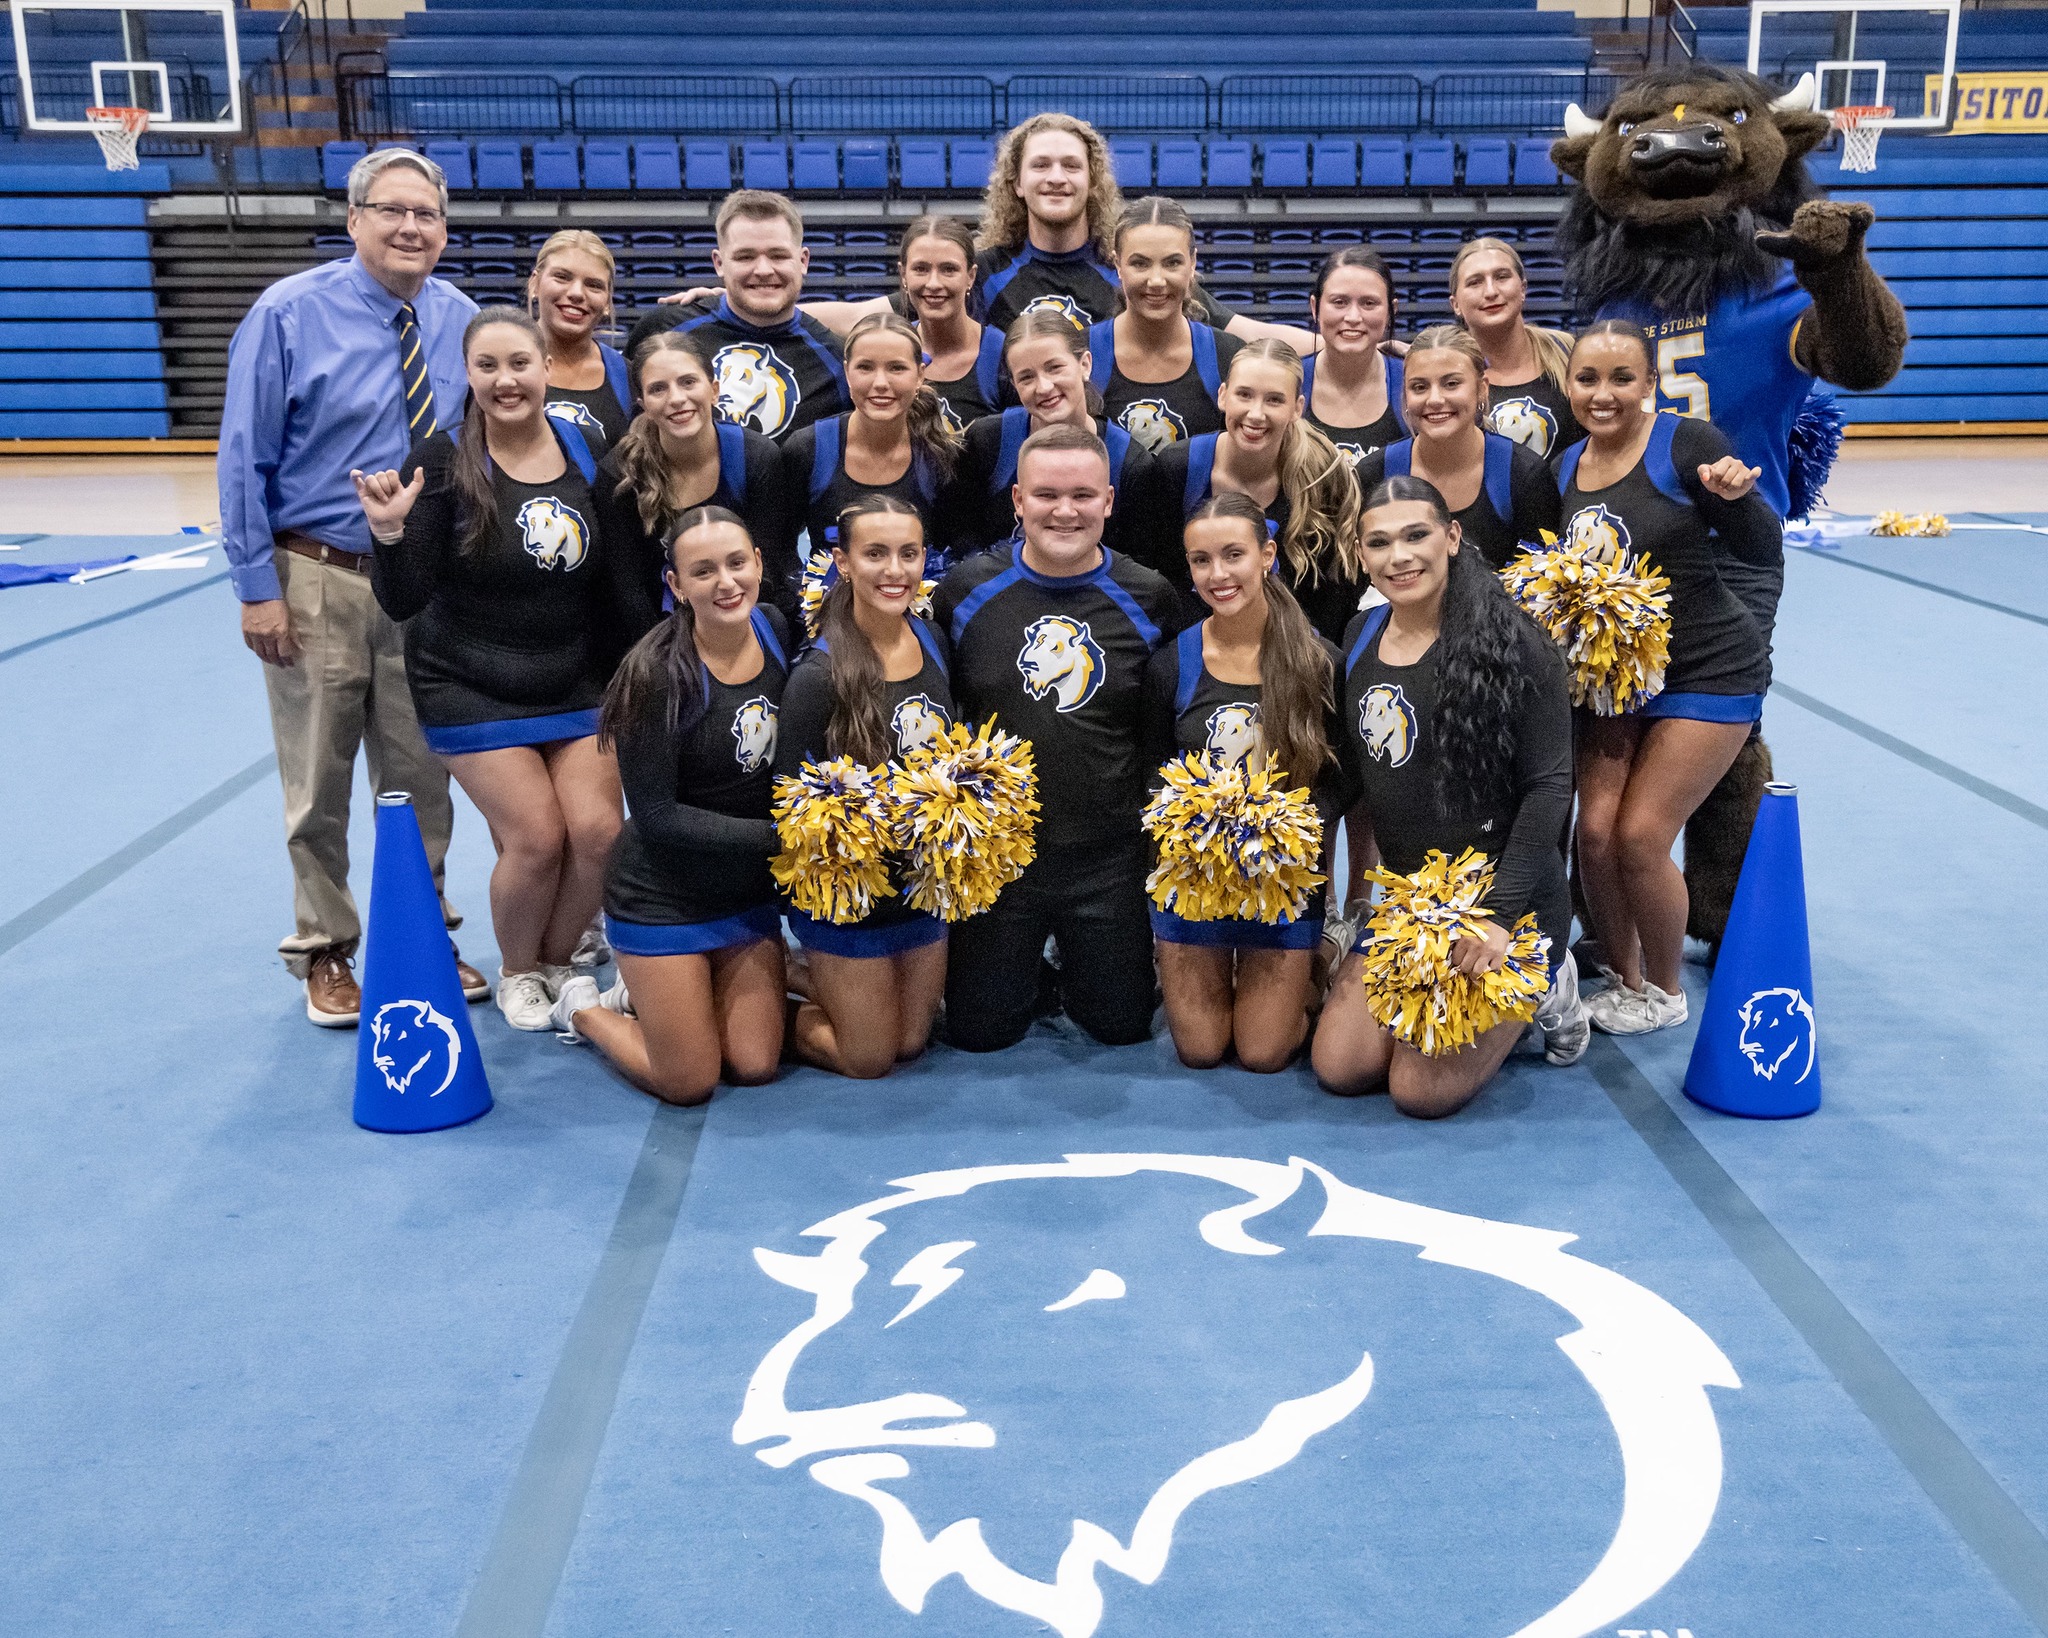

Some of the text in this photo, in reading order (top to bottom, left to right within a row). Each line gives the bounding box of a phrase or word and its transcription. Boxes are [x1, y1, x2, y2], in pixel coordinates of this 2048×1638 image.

[1931, 87, 2048, 120] SITO
[1660, 314, 1707, 335] STORM
[1641, 331, 1711, 422] 5
